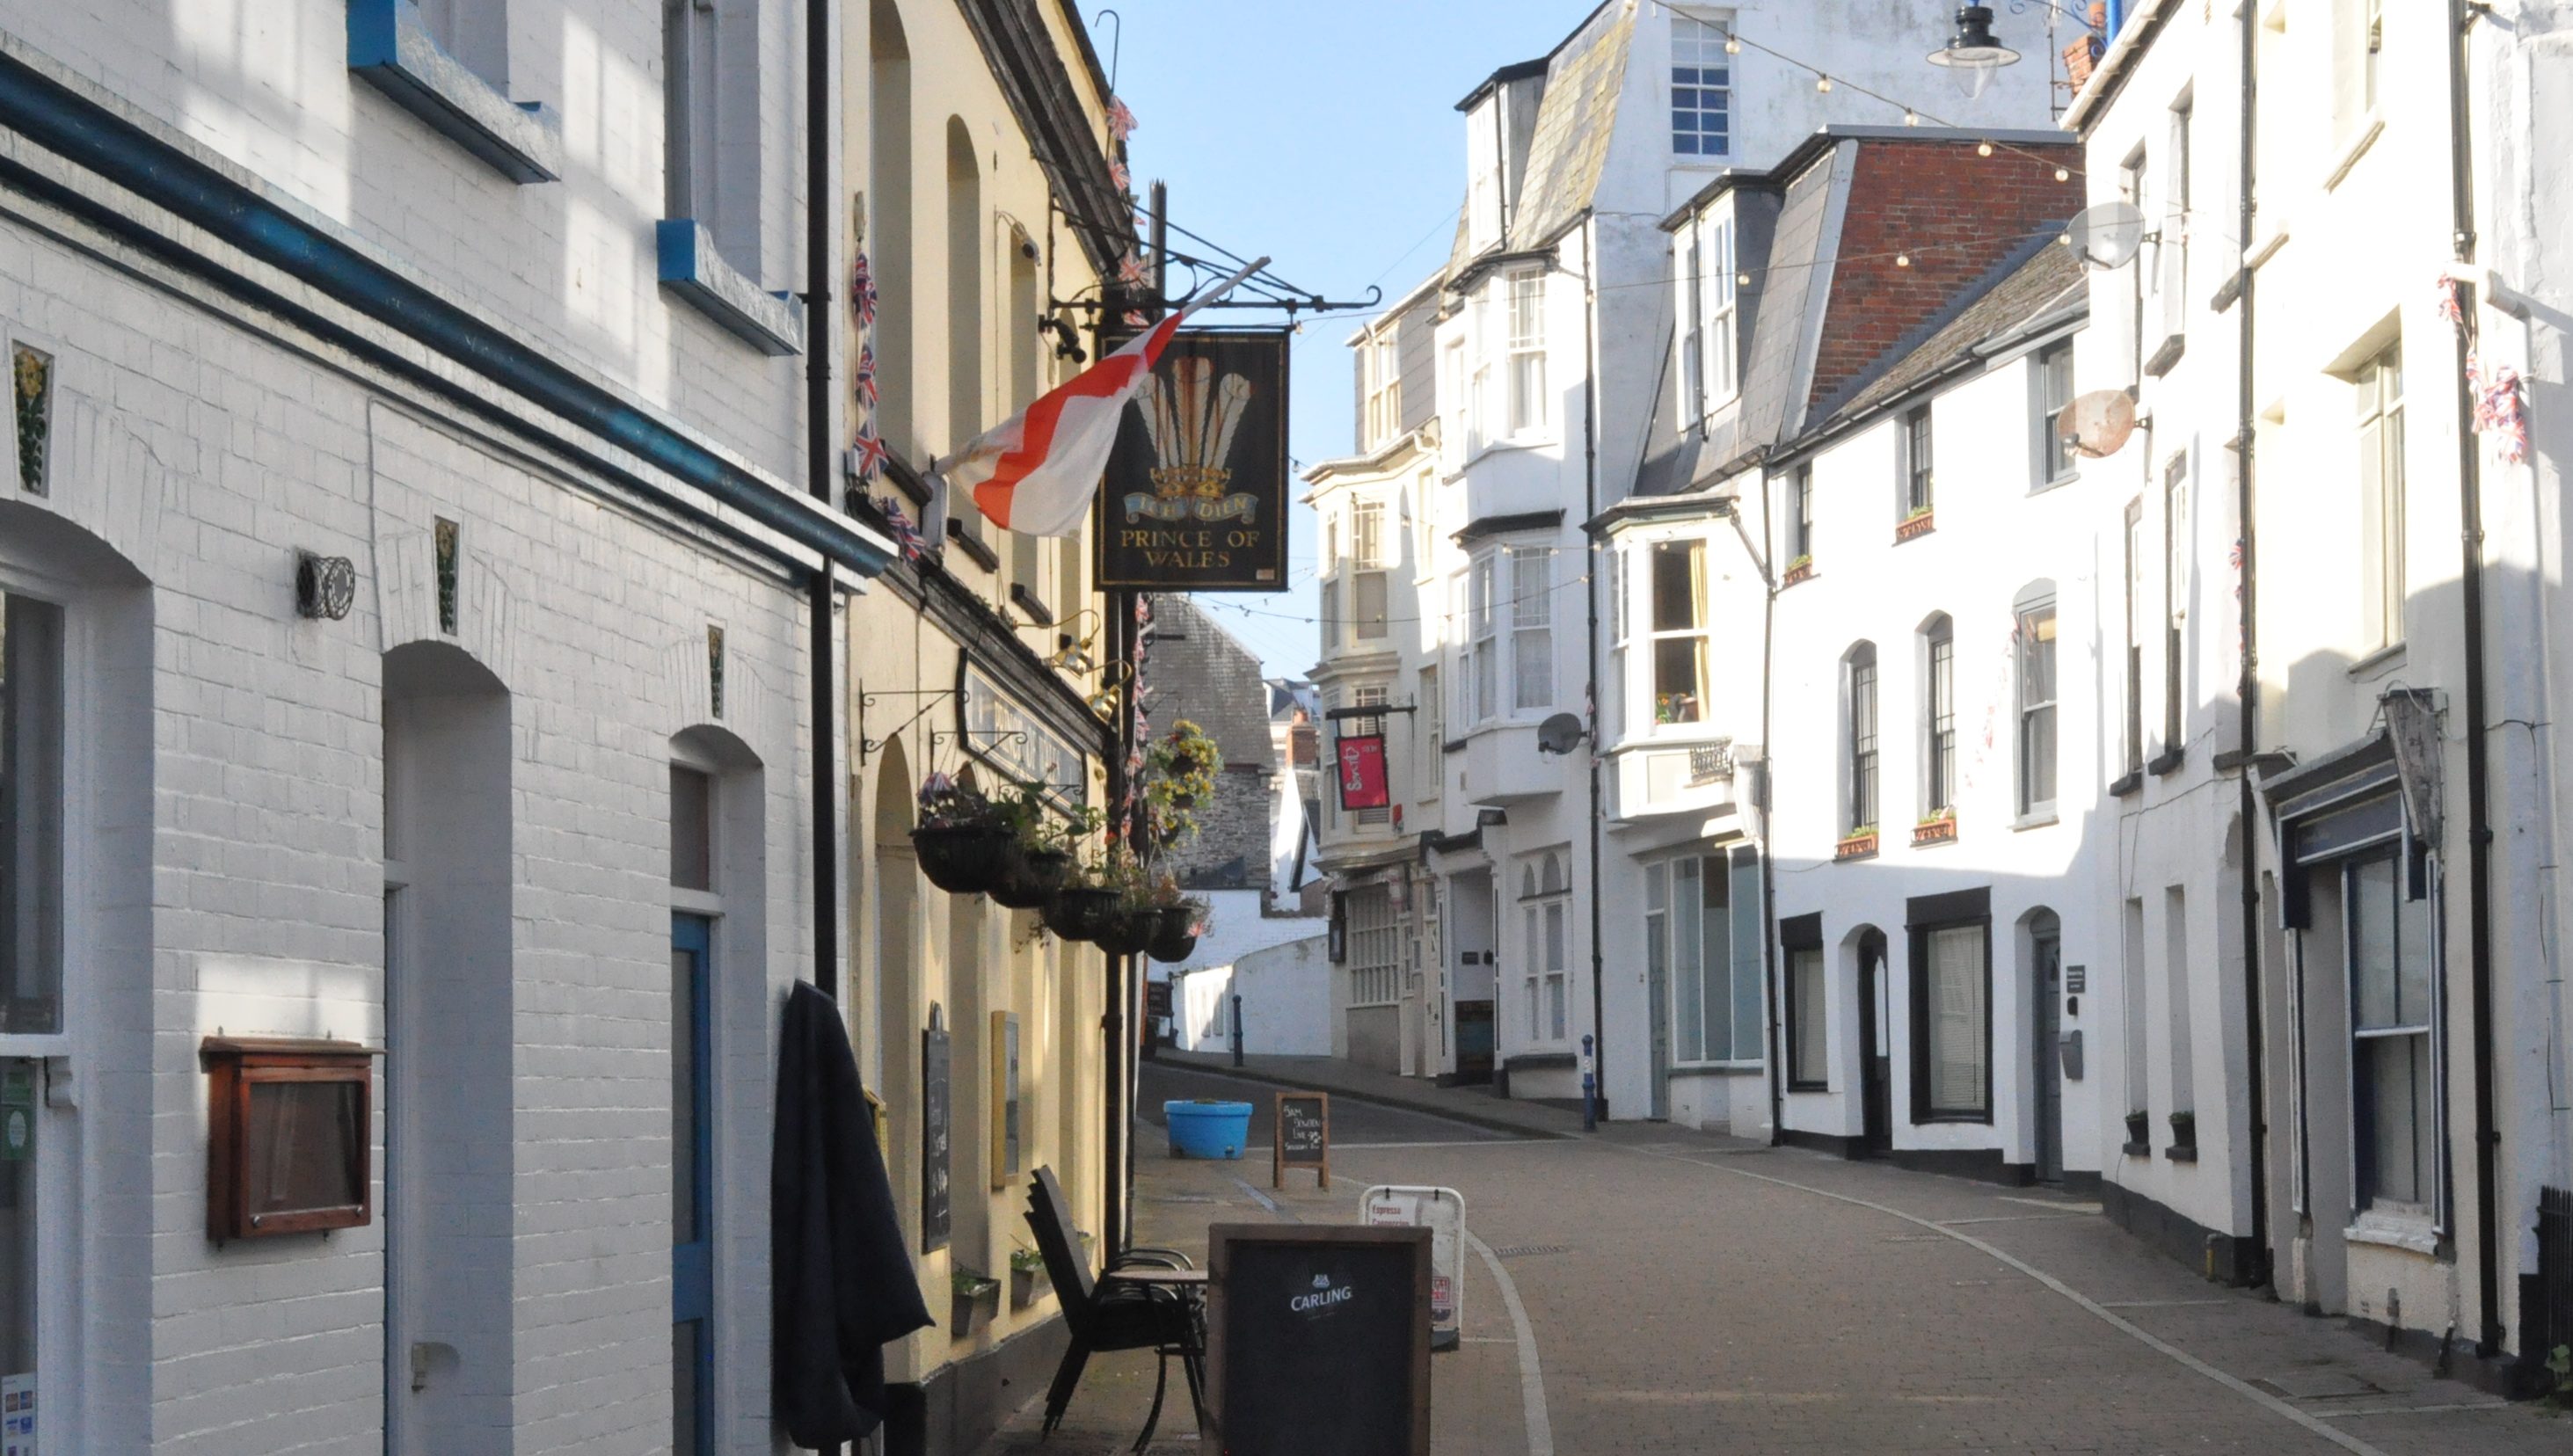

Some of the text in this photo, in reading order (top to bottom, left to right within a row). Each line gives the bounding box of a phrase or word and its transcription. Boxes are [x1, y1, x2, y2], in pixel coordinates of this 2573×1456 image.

[1200, 498, 1247, 517] DIEN
[1121, 530, 1260, 548] PRINCE OF
[1145, 551, 1230, 567] WALES
[1372, 1205, 1402, 1216] Espresso
[1291, 1285, 1352, 1311] CARLING
